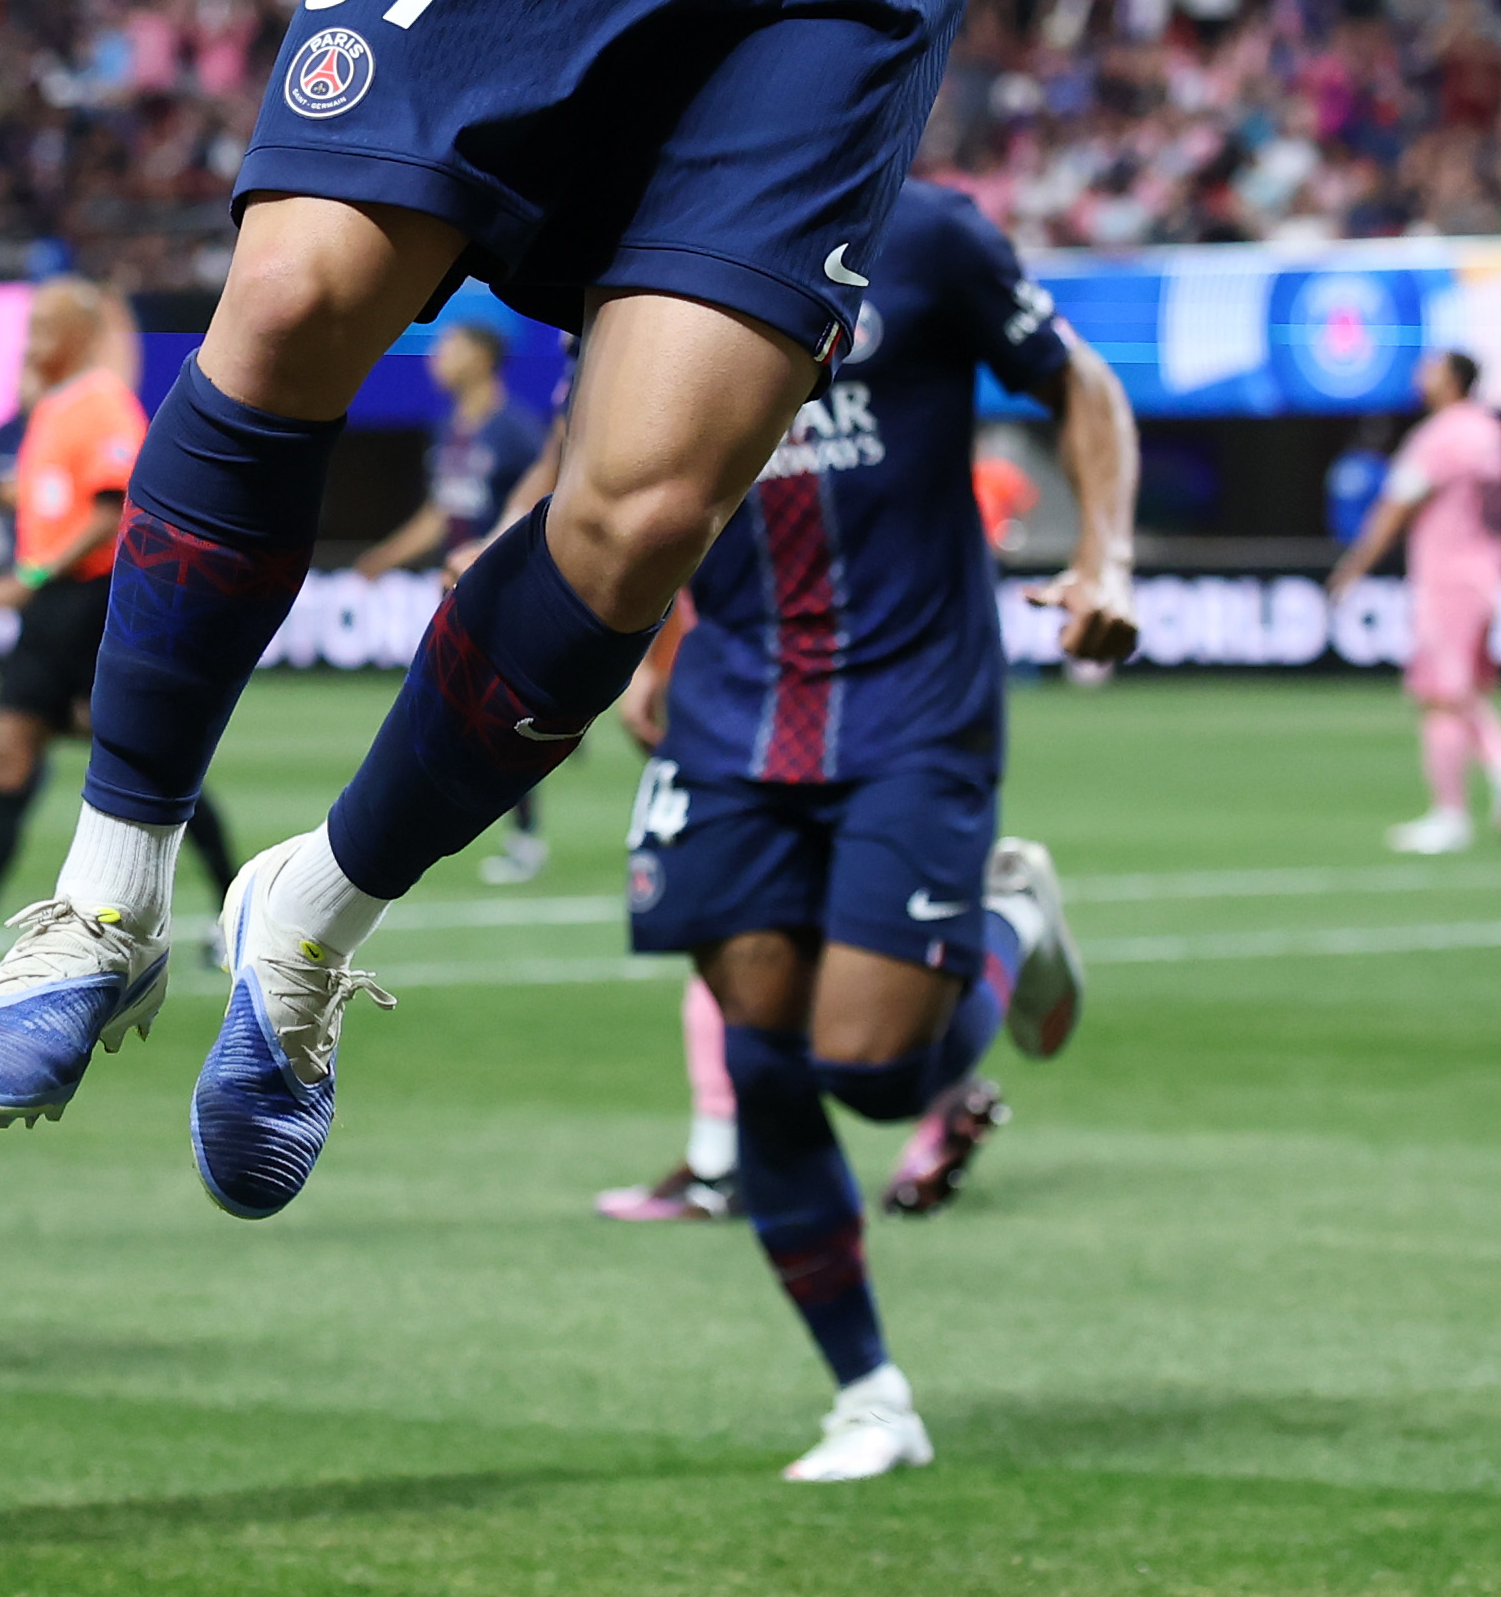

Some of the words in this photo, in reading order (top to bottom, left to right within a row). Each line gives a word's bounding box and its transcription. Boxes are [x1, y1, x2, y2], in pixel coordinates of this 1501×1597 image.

[308, 33, 364, 59] PARIS
[311, 96, 347, 111] GERMAIN
[1134, 575, 1328, 666] ORLD
